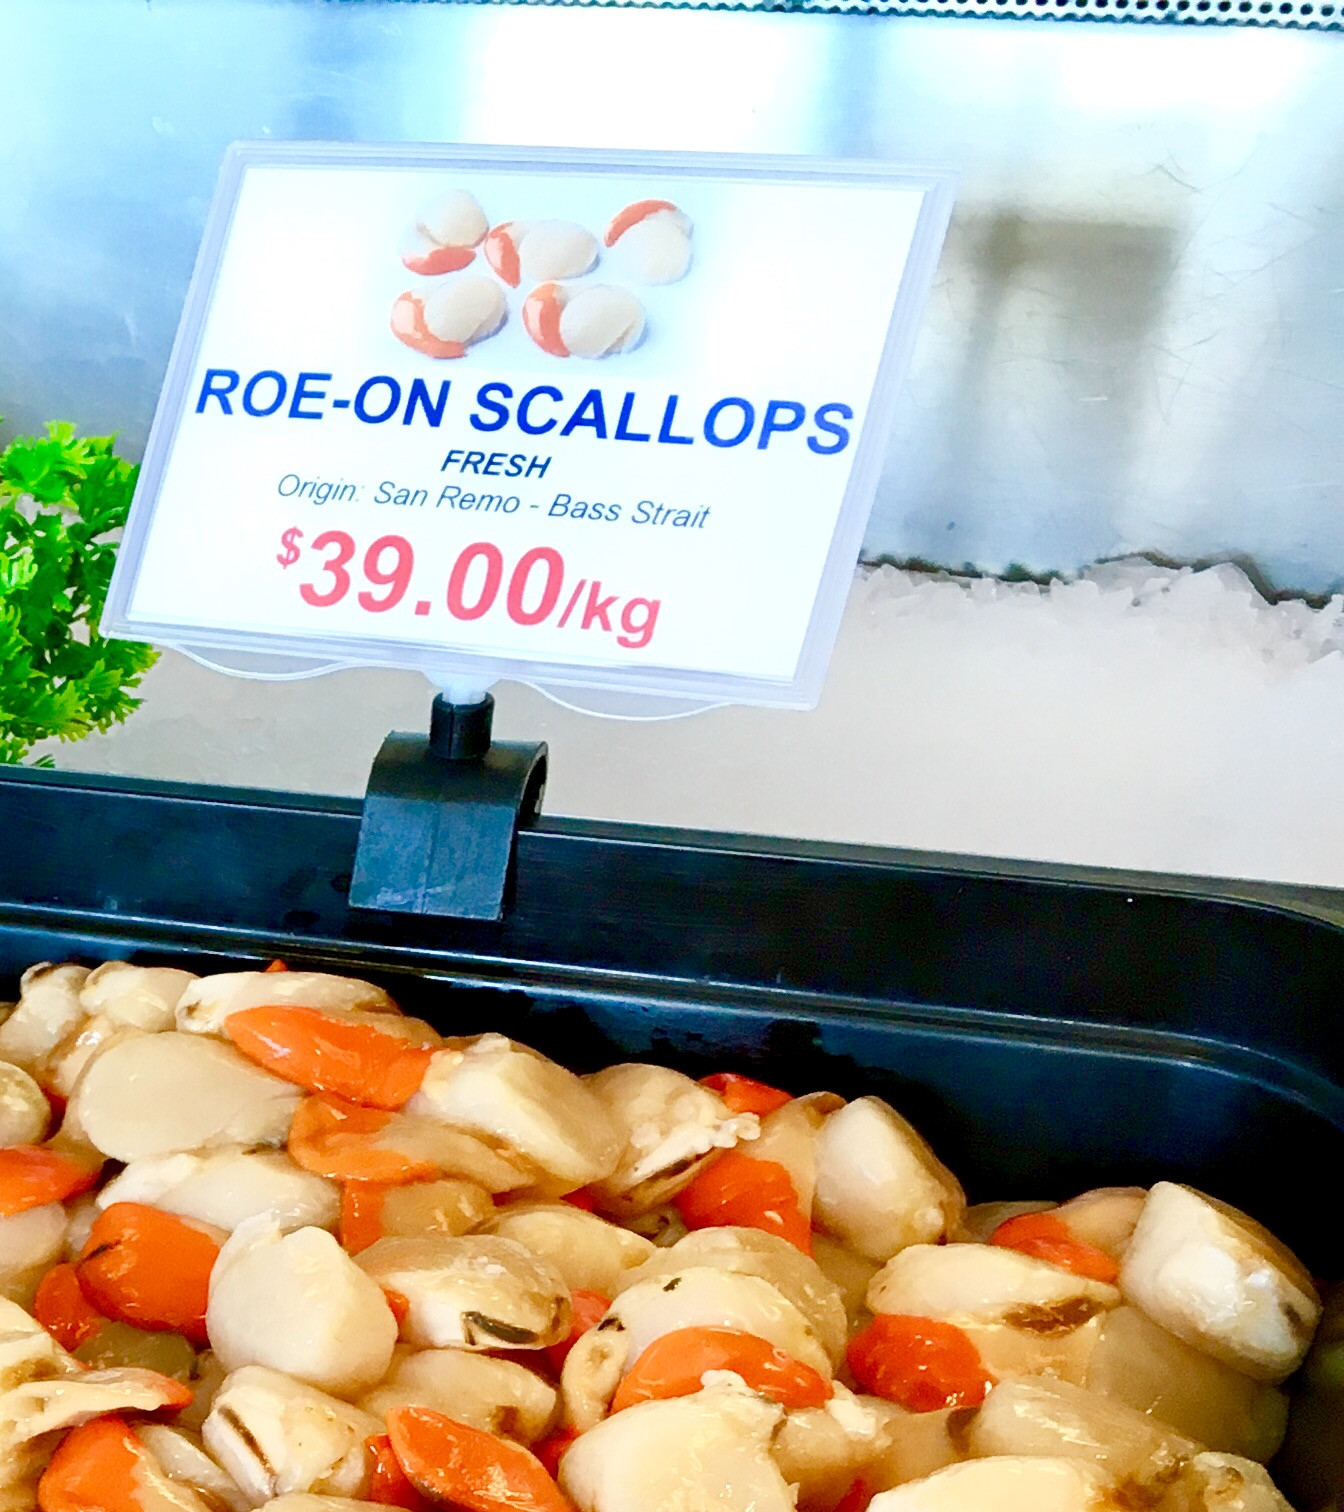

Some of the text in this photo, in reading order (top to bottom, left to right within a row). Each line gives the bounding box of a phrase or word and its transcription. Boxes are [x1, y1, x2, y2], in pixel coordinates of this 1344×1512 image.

[194, 367, 856, 457] ROE-ON SCALLOPS
[276, 473, 365, 505] Origin:
[373, 480, 429, 507] San
[435, 485, 521, 514] Remo
[548, 493, 622, 522] Bass
[631, 500, 712, 529] Strait
[440, 449, 553, 480] FRESH
[276, 525, 662, 649] $39.00/kg
